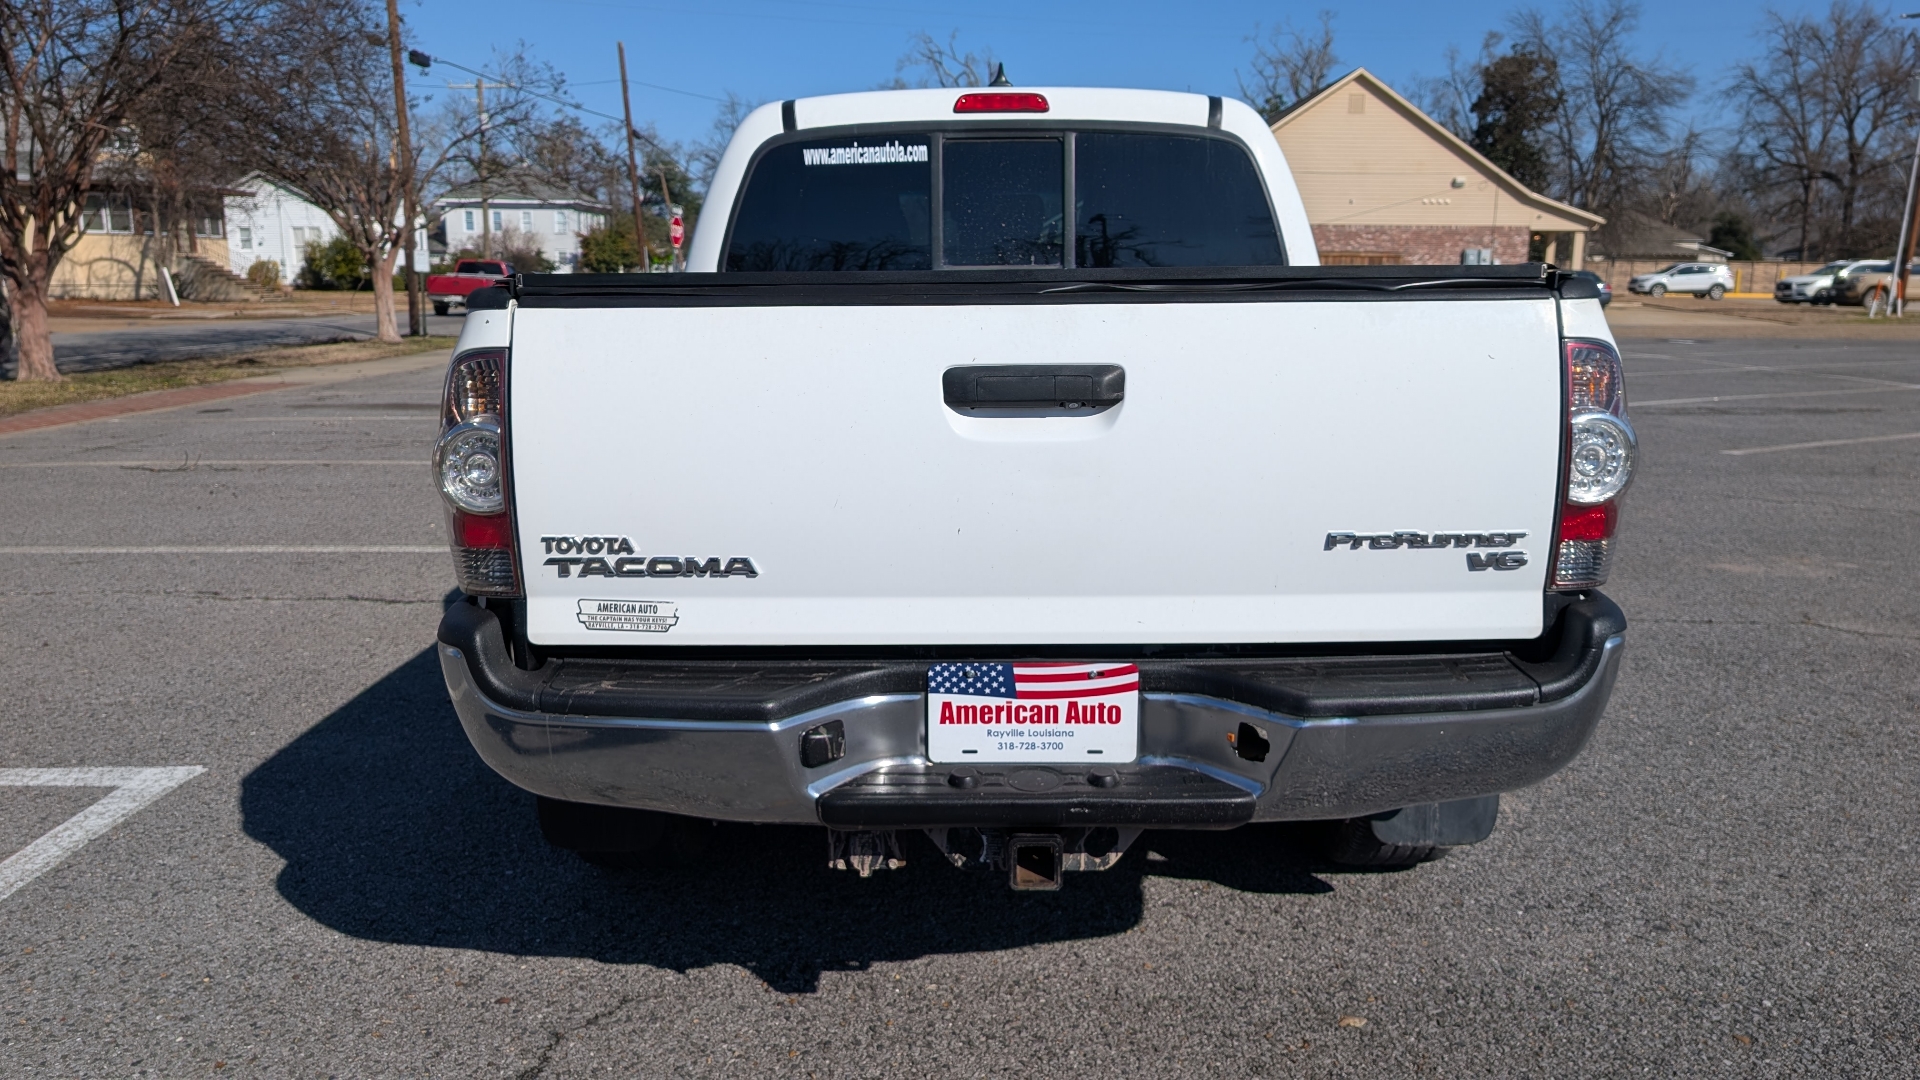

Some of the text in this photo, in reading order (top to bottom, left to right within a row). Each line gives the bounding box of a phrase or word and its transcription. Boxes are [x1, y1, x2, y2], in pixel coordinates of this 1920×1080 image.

[803, 140, 928, 165] www.americanautola.com
[540, 534, 638, 555] TOYOTA
[543, 556, 762, 579] TACOMA
[1466, 551, 1529, 572] V6
[597, 602, 658, 615] AMERICAN AUTO
[939, 700, 1122, 725] American Auto
[986, 728, 1075, 738] Rayville Louisiana
[997, 742, 1064, 751] 318-728-3700
